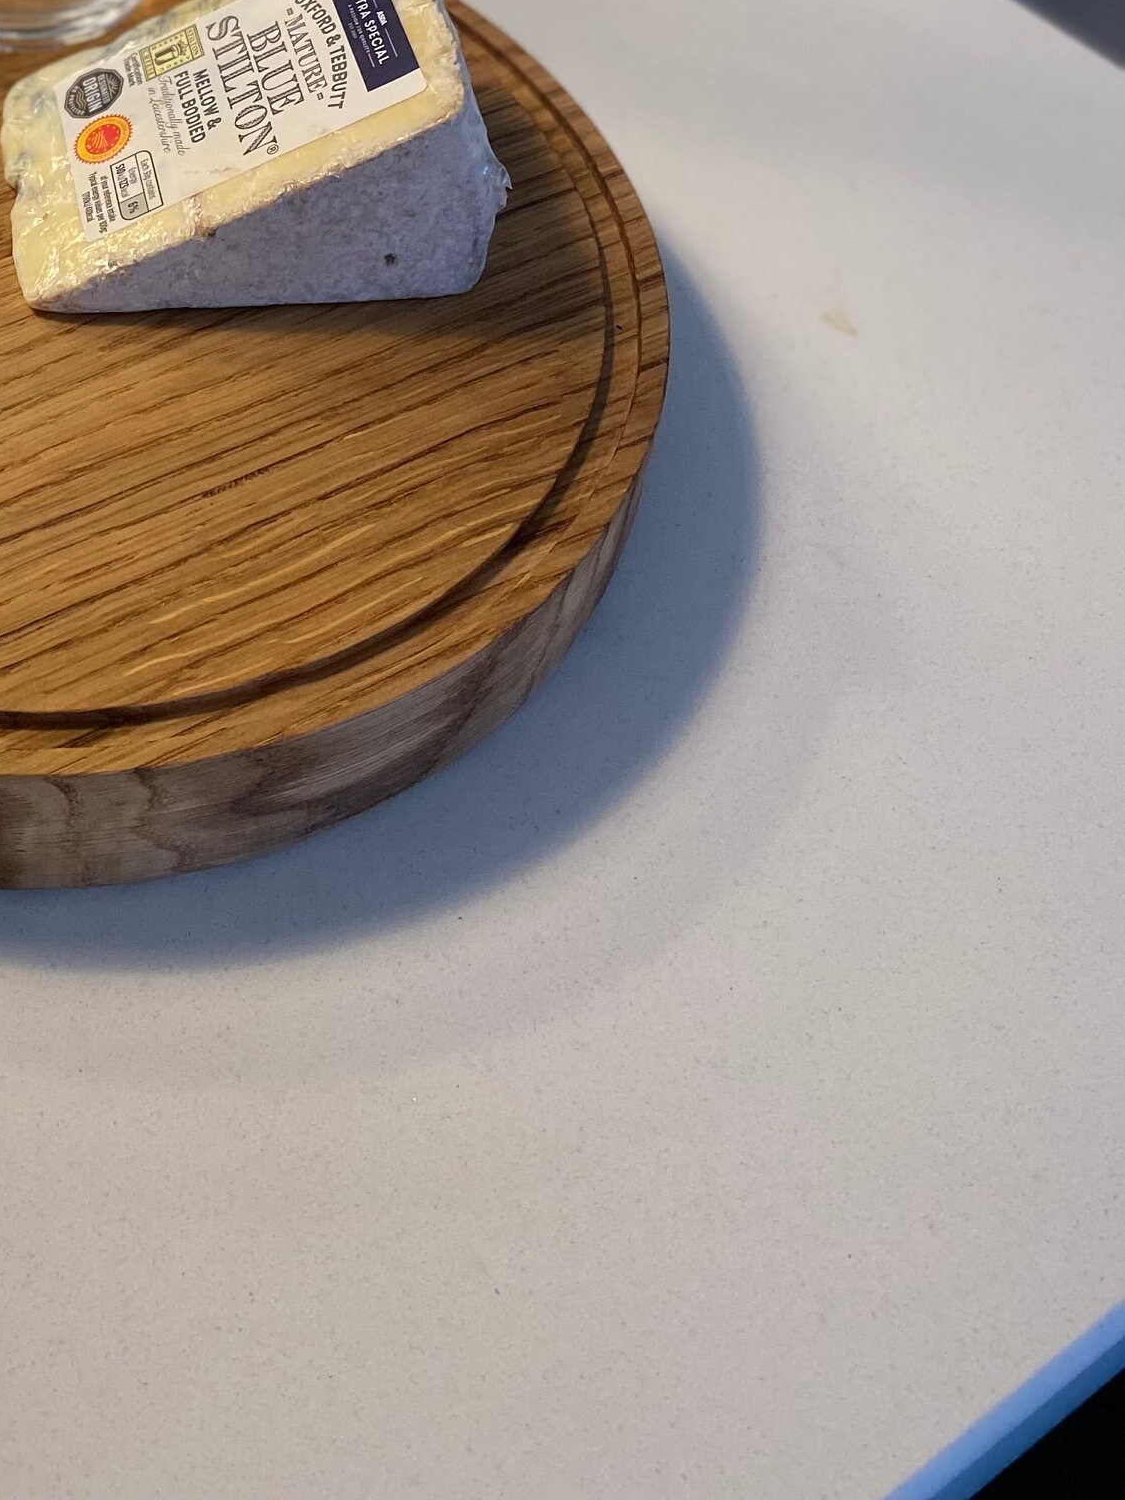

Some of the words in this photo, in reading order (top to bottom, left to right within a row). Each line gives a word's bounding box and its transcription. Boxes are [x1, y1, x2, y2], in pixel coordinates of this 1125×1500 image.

[376, 11, 388, 26] ASDA
[186, 28, 199, 56] STILTON
[325, 34, 342, 47] &
[359, 34, 371, 54] QUALITY
[364, 19, 390, 65] SPECIAL
[130, 52, 143, 85] Certification
[174, 70, 193, 100] FULL
[247, 20, 305, 115] BLUE
[327, 45, 348, 109] TEBBUTT
[82, 76, 103, 113] ORIGIN
[148, 87, 156, 97] in
[192, 68, 220, 117] MELLOW
[206, 117, 222, 131] &
[148, 97, 173, 153] Leicestershire
[157, 75, 183, 131] Traditionally
[173, 130, 191, 156] made
[181, 97, 206, 143] BODIED
[128, 166, 137, 184] Energy
[140, 158, 149, 171] Each
[145, 180, 156, 200] contains
[128, 201, 140, 214] 6%
